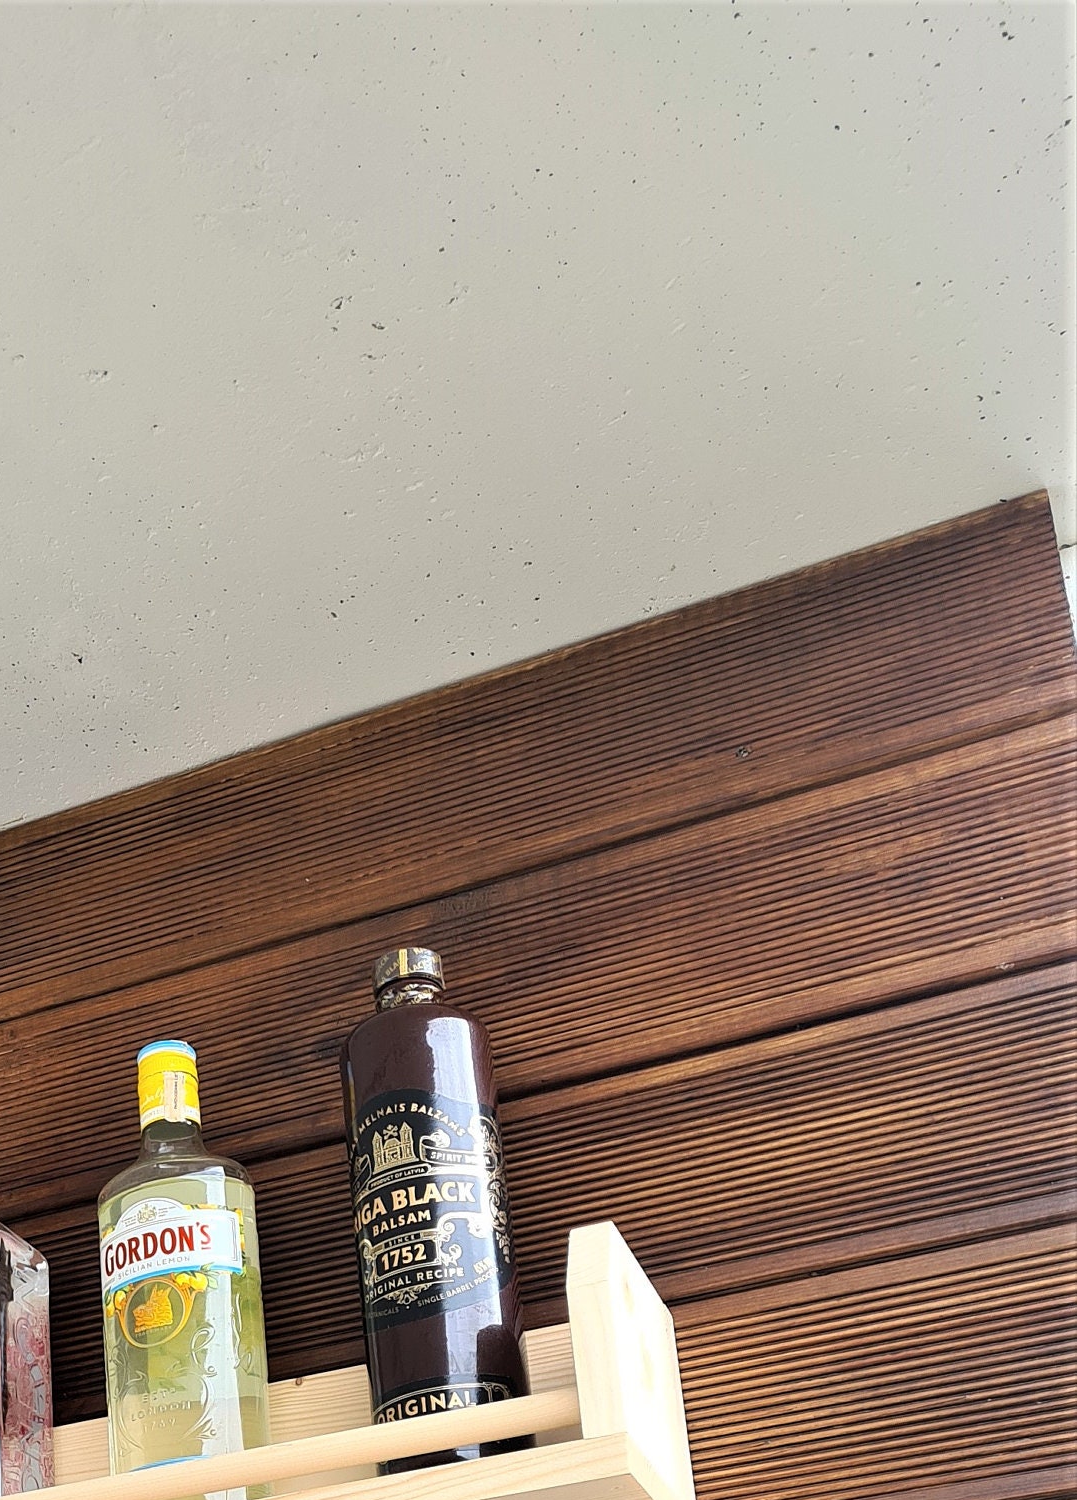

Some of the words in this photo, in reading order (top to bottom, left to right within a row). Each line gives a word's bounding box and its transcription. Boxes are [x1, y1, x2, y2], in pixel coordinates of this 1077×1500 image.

[358, 1102, 406, 1135] MELNAIS
[410, 1102, 466, 1137] BALZAMS
[430, 1151, 464, 1164] SPIRIT
[394, 1172, 403, 1180] OF
[403, 1167, 426, 1177] LATVIA
[390, 1181, 476, 1213] BLACK
[372, 1209, 432, 1237] BALSAM
[105, 1221, 212, 1277] GORDON'S
[387, 1234, 416, 1249] SINCE
[117, 1261, 153, 1281] SICILIAN
[156, 1256, 190, 1267] LEMON
[380, 1243, 427, 1272] 1752
[364, 1277, 411, 1304] ORIGINAL
[416, 1266, 466, 1282] RECIPE
[416, 1292, 445, 1308] SINGLE
[445, 1281, 474, 1299] BARREL
[377, 1390, 477, 1424] ORIGINAL
